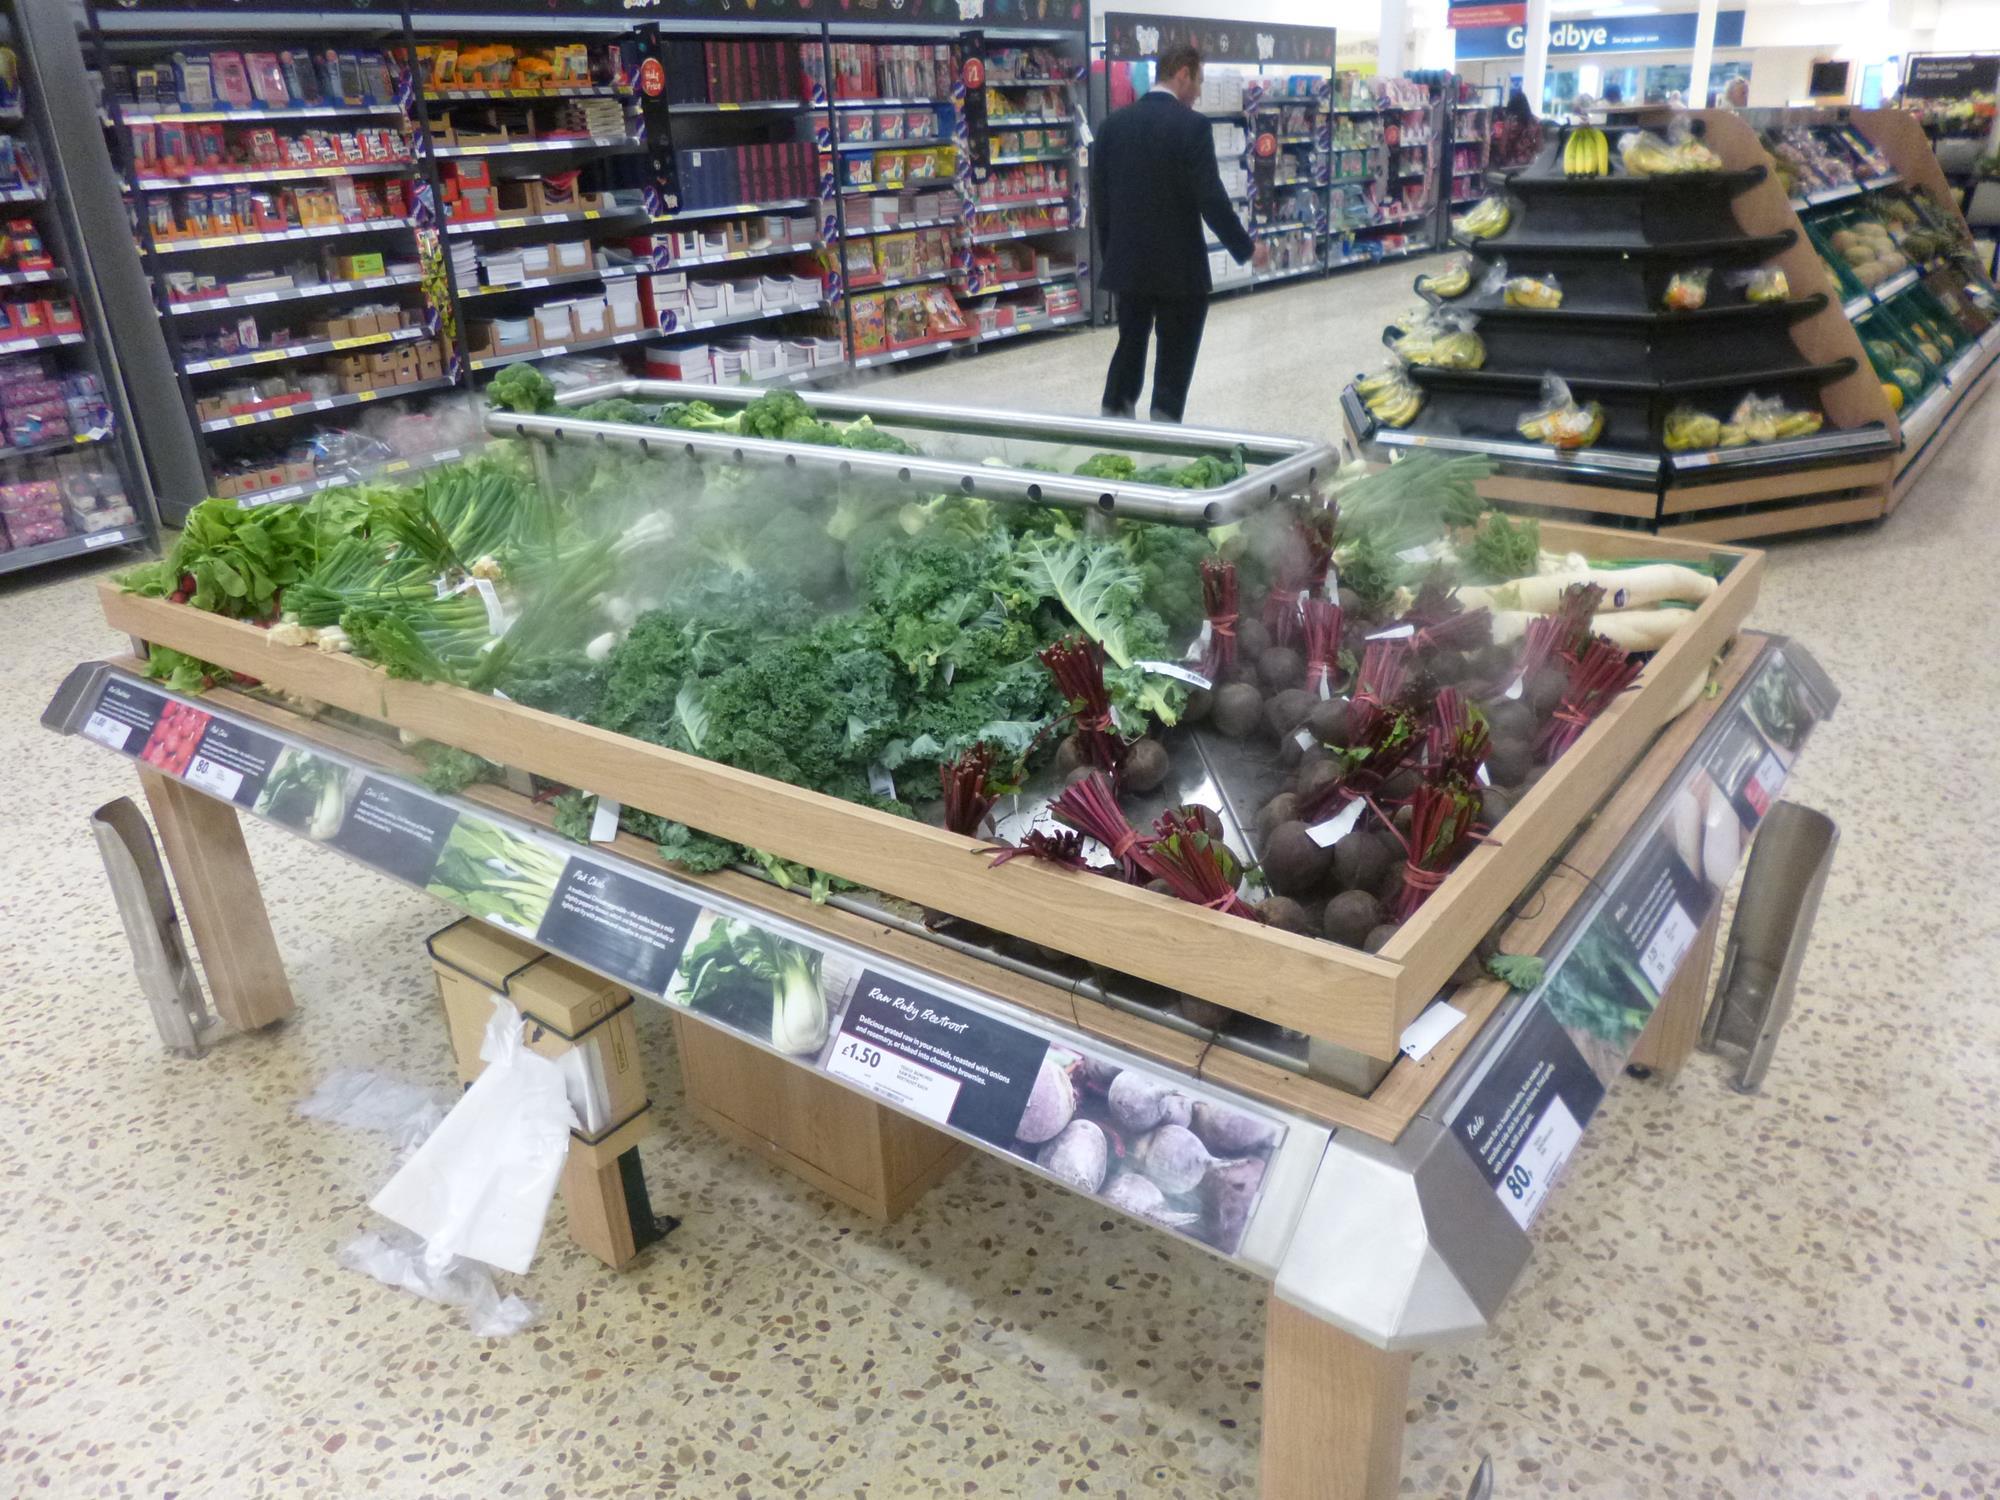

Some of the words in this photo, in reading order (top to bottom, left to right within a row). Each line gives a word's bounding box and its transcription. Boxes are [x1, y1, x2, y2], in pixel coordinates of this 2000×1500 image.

[1506, 24, 1607, 50] Gdbye
[868, 987, 892, 1003] Raw
[892, 997, 920, 1021] Ruby
[920, 1009, 969, 1034] Beetroot
[841, 1043, 881, 1068] £1.50
[855, 1025, 868, 1034] and
[866, 1030, 894, 1047] rosemary,
[899, 1042, 919, 1056] baked
[917, 1050, 930, 1061] into
[929, 1056, 958, 1073] chocolate
[957, 1067, 986, 1086] brownies.
[859, 1014, 885, 1031] Delicious
[883, 1026, 904, 1039] grated
[902, 1034, 914, 1043] raw
[913, 1037, 920, 1046] in
[918, 1041, 934, 1051] your
[932, 1046, 953, 1061] salads,
[952, 1055, 977, 1069] roasted
[975, 1065, 990, 1075] with
[989, 1070, 1010, 1084] onions
[1466, 1116, 1485, 1140] Kale
